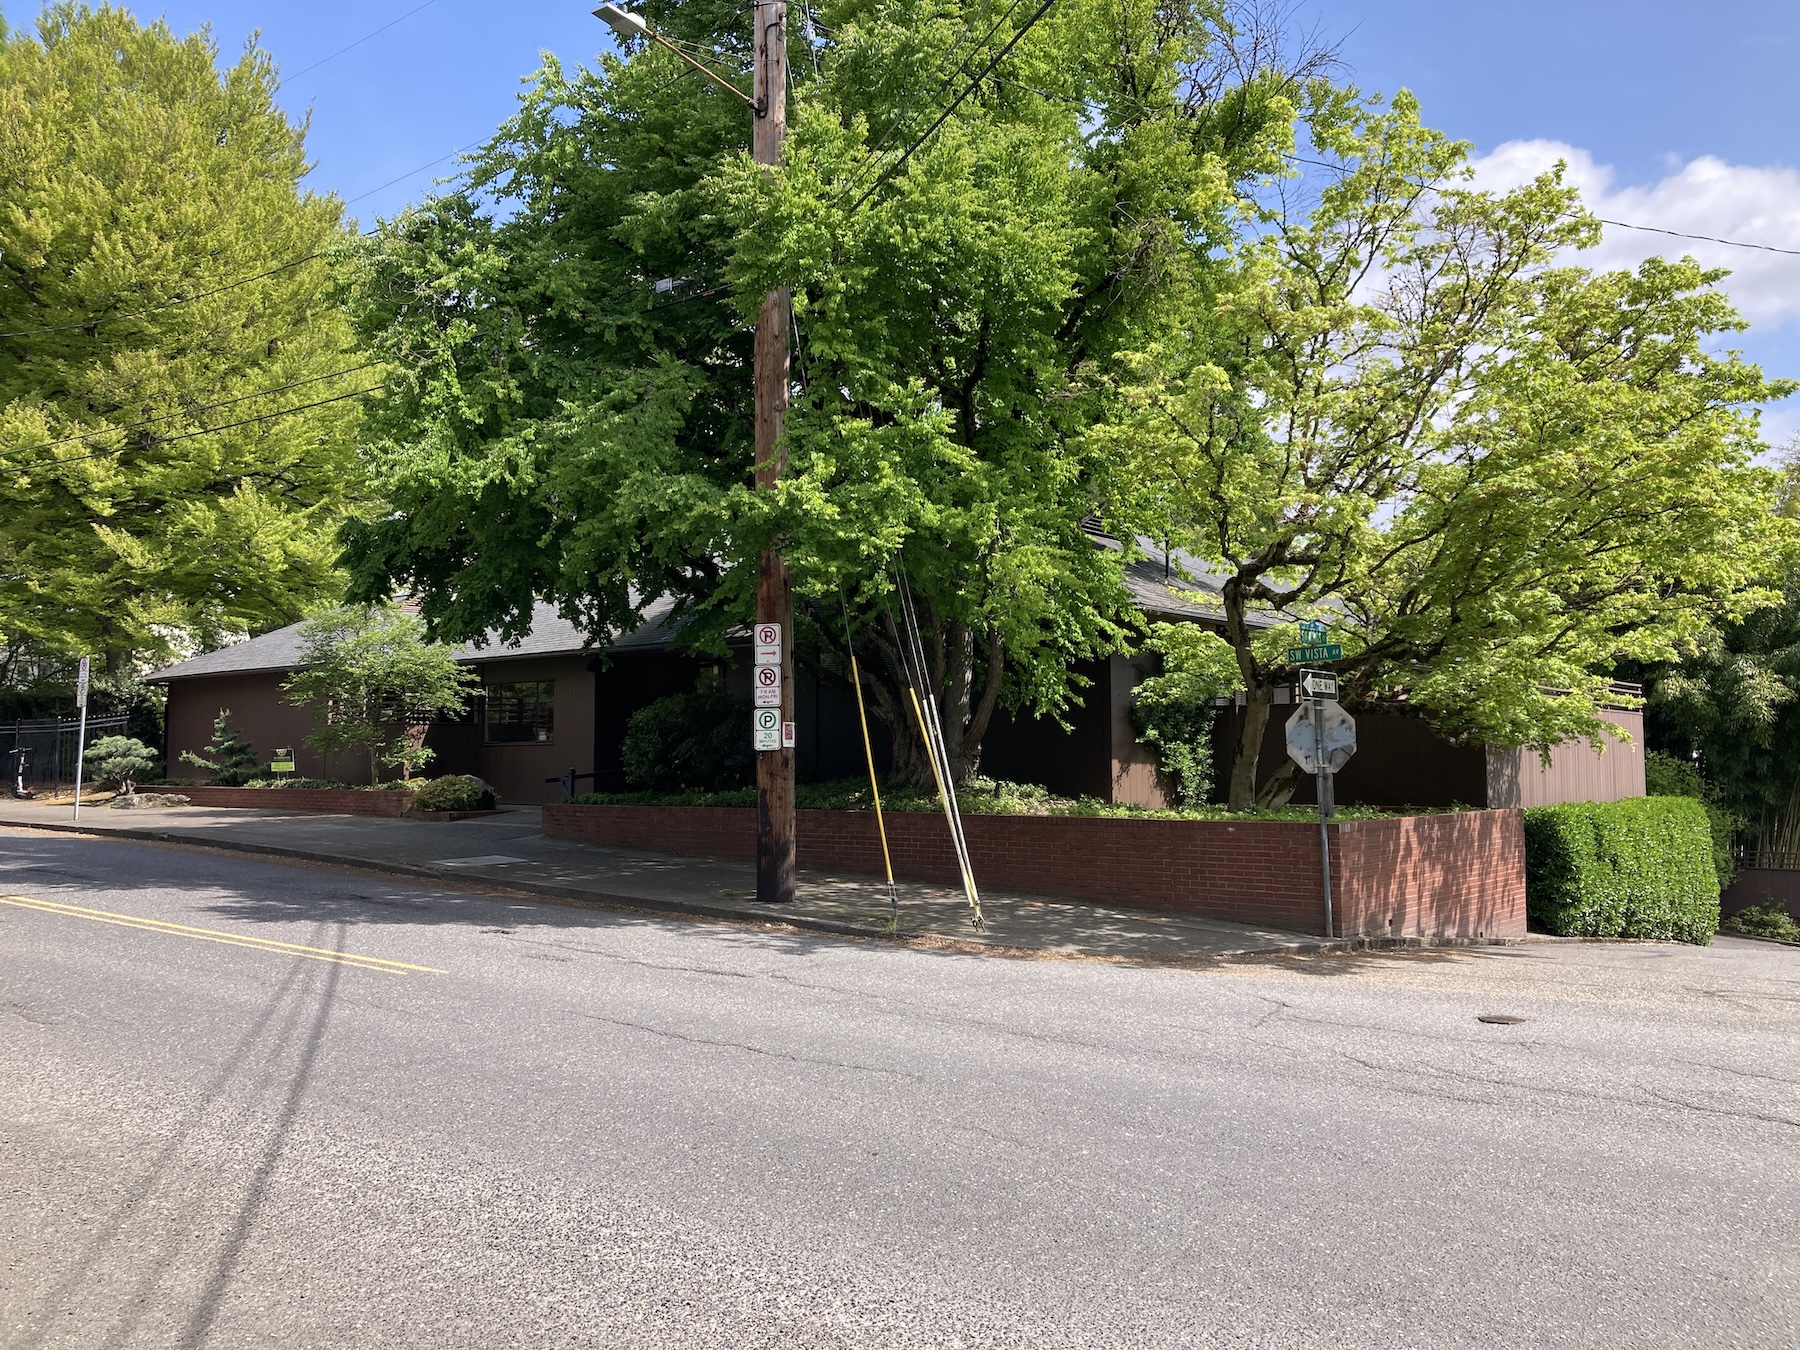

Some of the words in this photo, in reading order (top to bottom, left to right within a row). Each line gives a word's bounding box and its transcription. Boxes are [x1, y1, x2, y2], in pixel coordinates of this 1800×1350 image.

[1290, 650, 1302, 661] SW
[1305, 647, 1329, 659] VISTA
[1312, 678, 1323, 691] ONE
[1323, 680, 1334, 692] WAY
